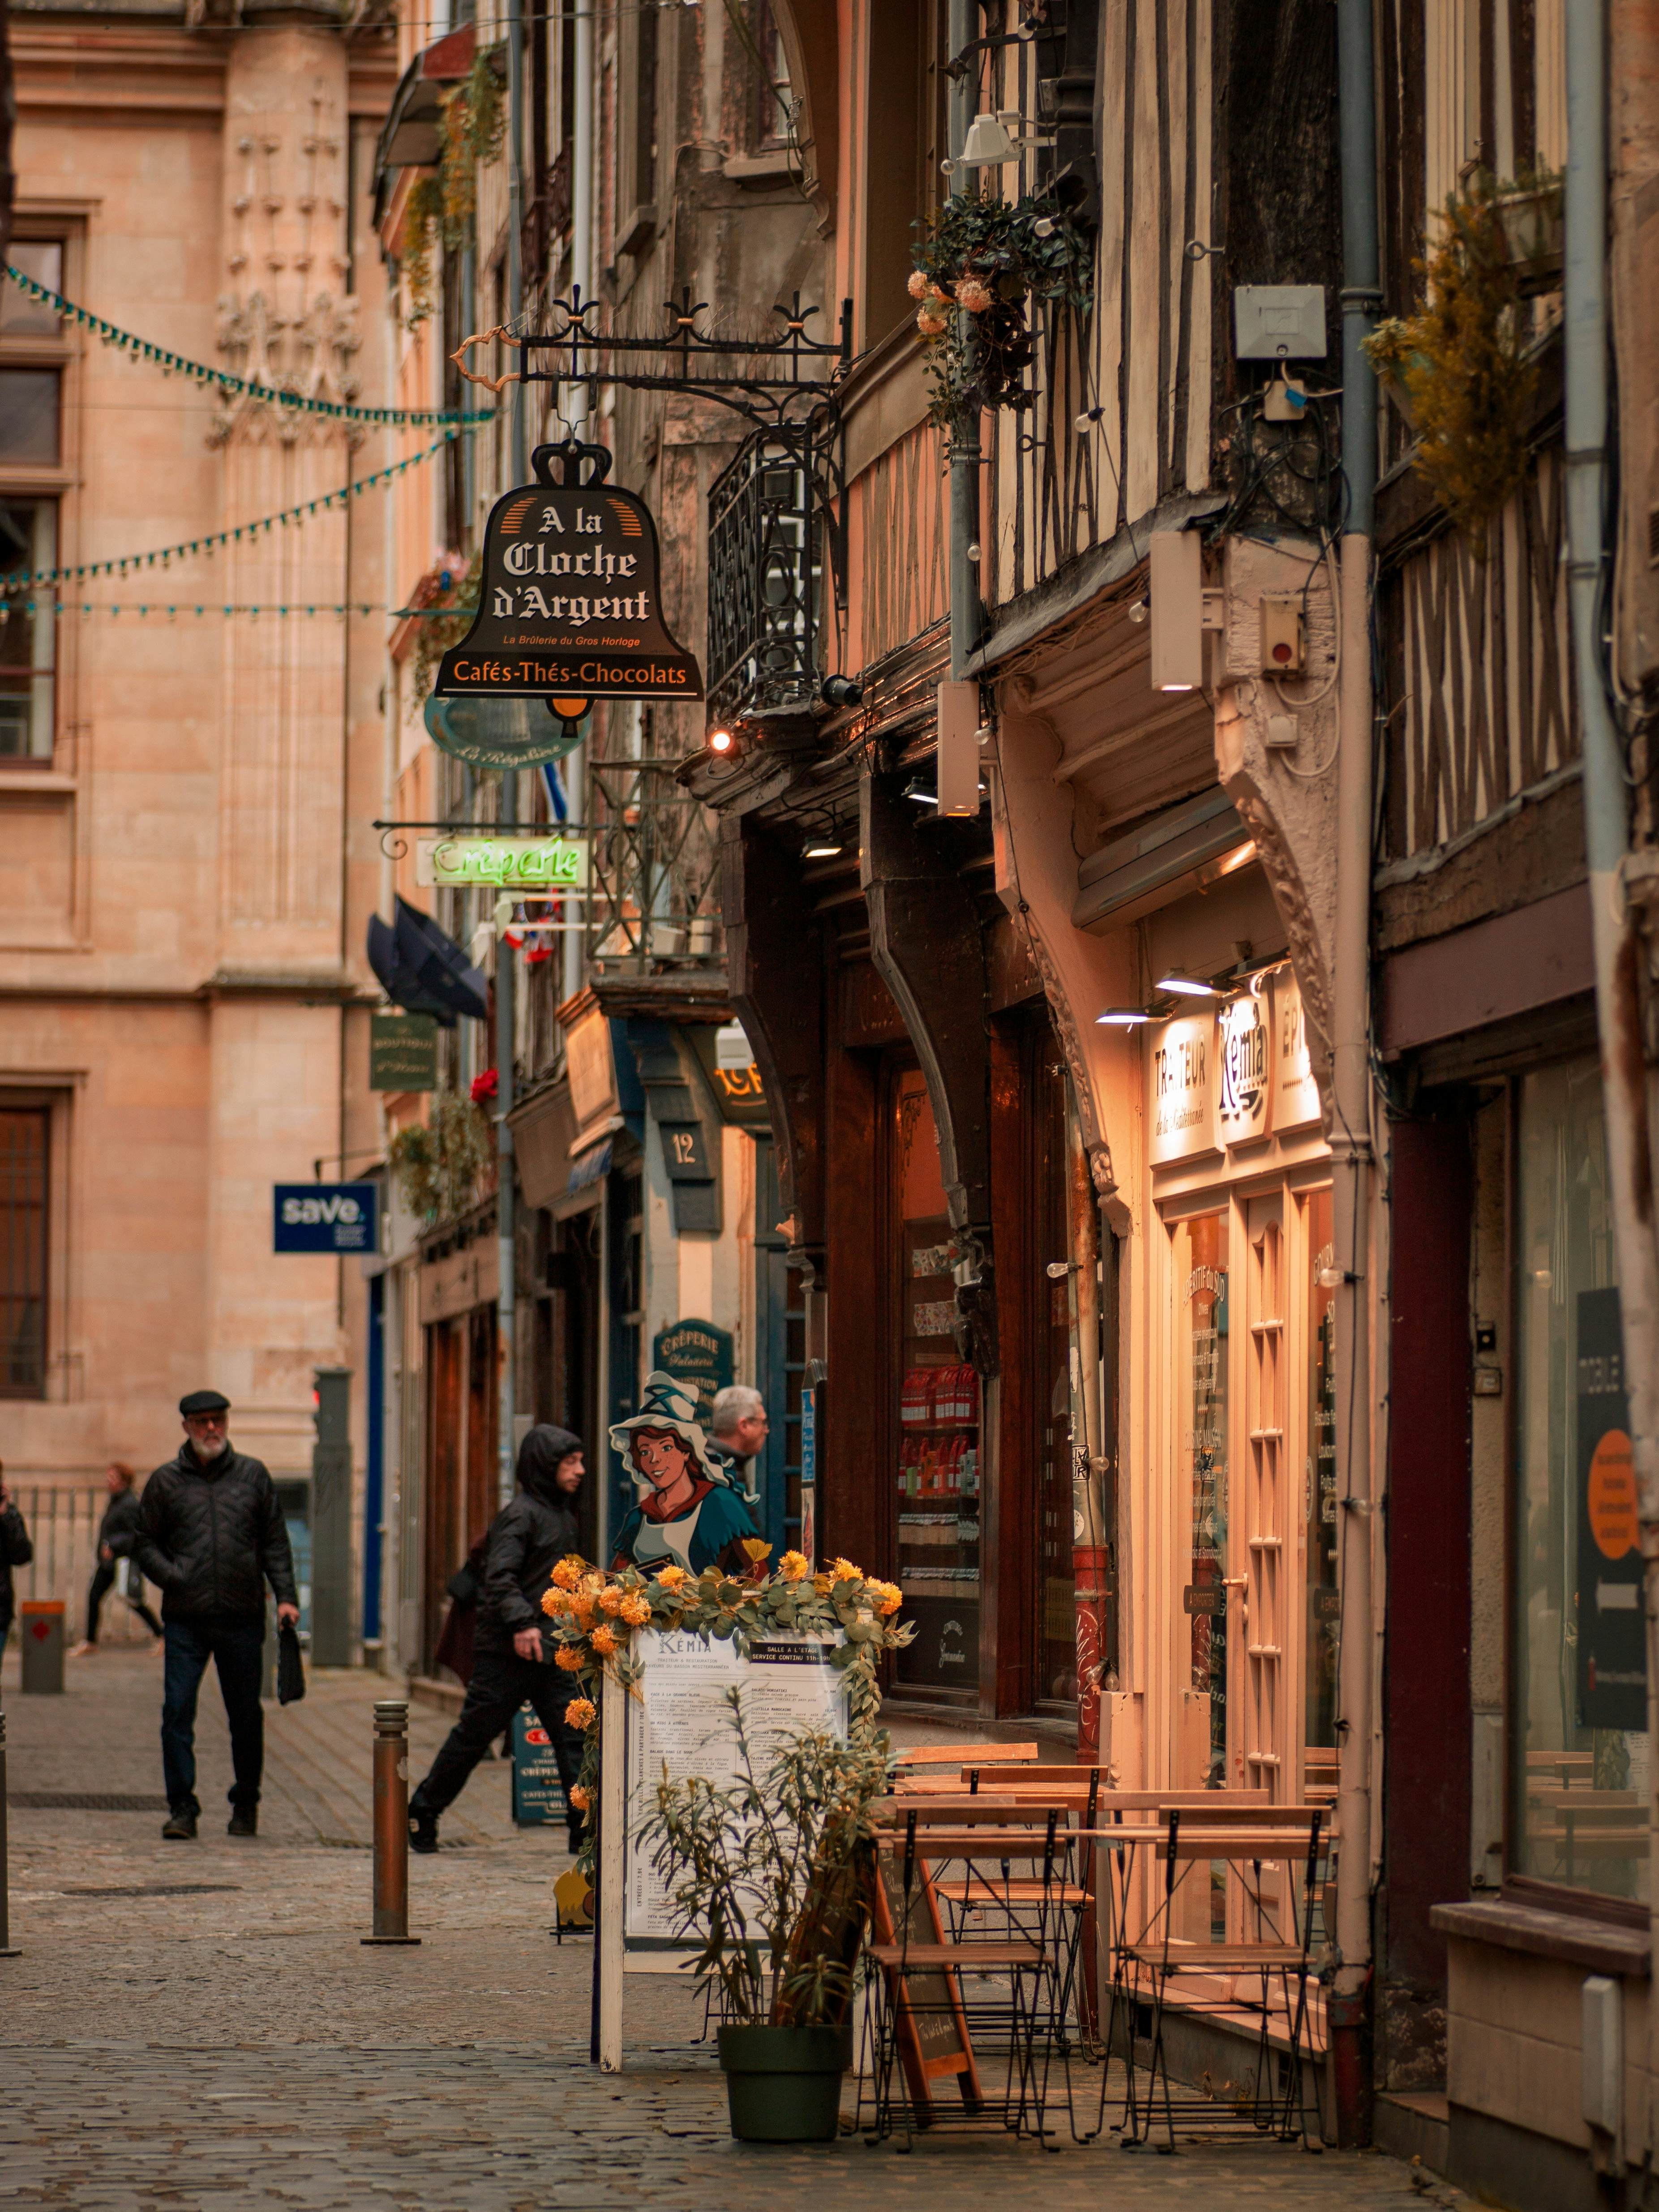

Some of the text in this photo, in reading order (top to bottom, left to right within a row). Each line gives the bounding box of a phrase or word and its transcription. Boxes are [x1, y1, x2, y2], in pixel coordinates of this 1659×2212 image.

[538, 506, 602, 534] A la
[503, 542, 638, 584] Cloche
[492, 586, 650, 626] d'Argent
[503, 635, 640, 647] La Brûlerie du Gros Horloge
[454, 661, 686, 684] Cafés-Thés-Chocolats
[433, 838, 580, 885] Crêperie
[1155, 1035, 1205, 1097] TRATEUR
[673, 1133, 696, 1165] 12
